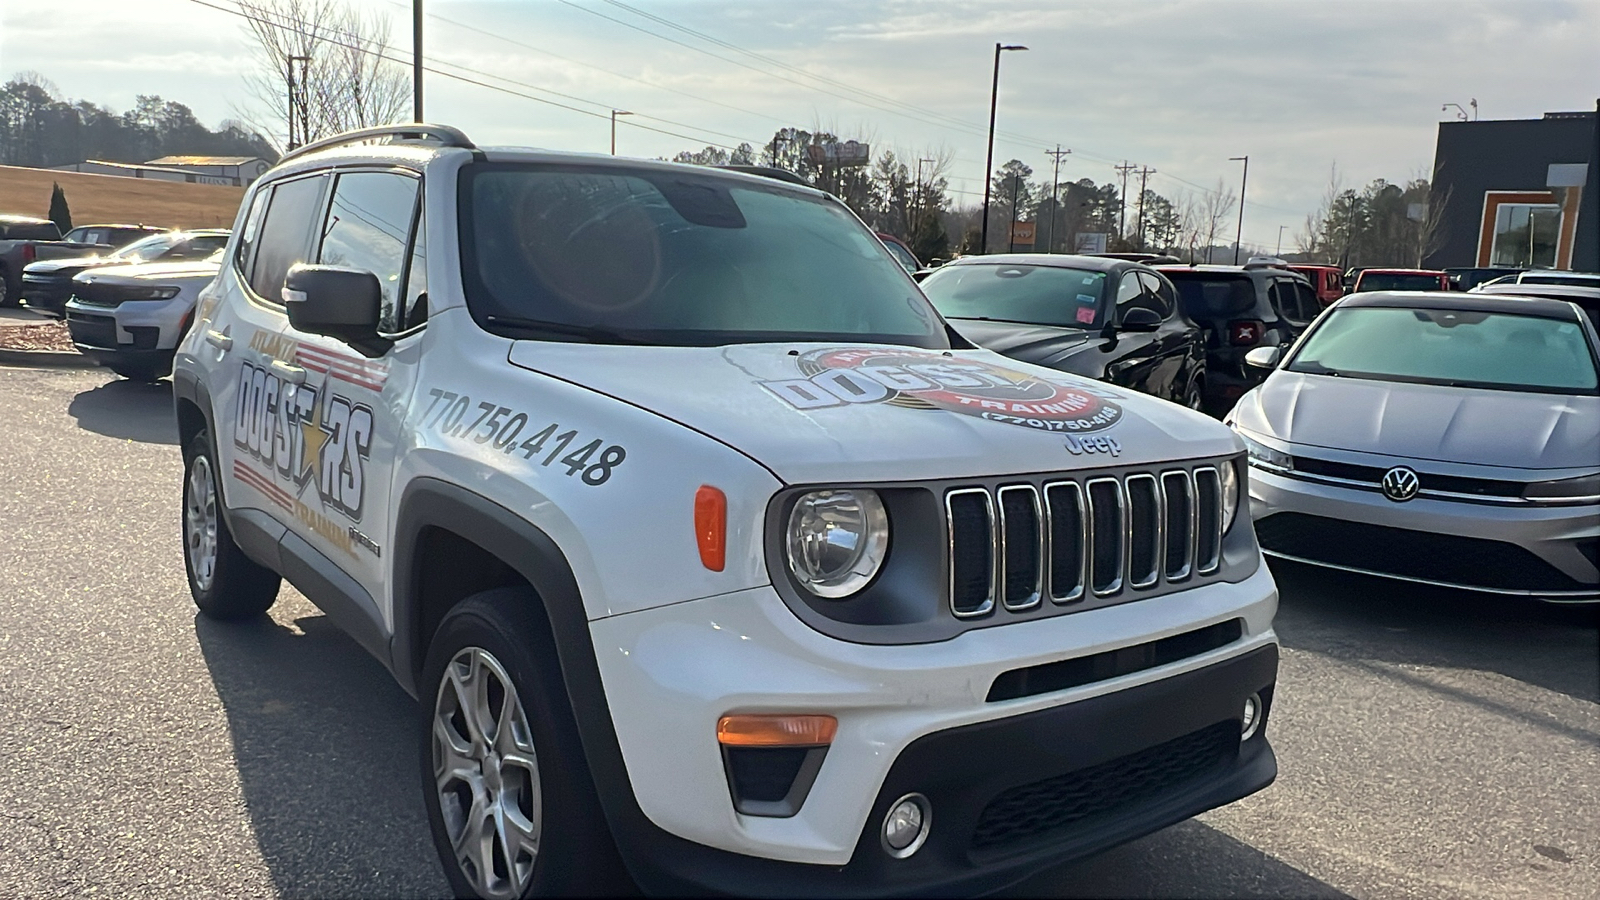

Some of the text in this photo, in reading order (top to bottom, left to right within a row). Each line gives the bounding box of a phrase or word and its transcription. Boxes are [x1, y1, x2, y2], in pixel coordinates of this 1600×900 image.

[954, 392, 1089, 415] TRAINING
[416, 387, 627, 487] 770.750.4148
[1064, 433, 1123, 457] Jeep
